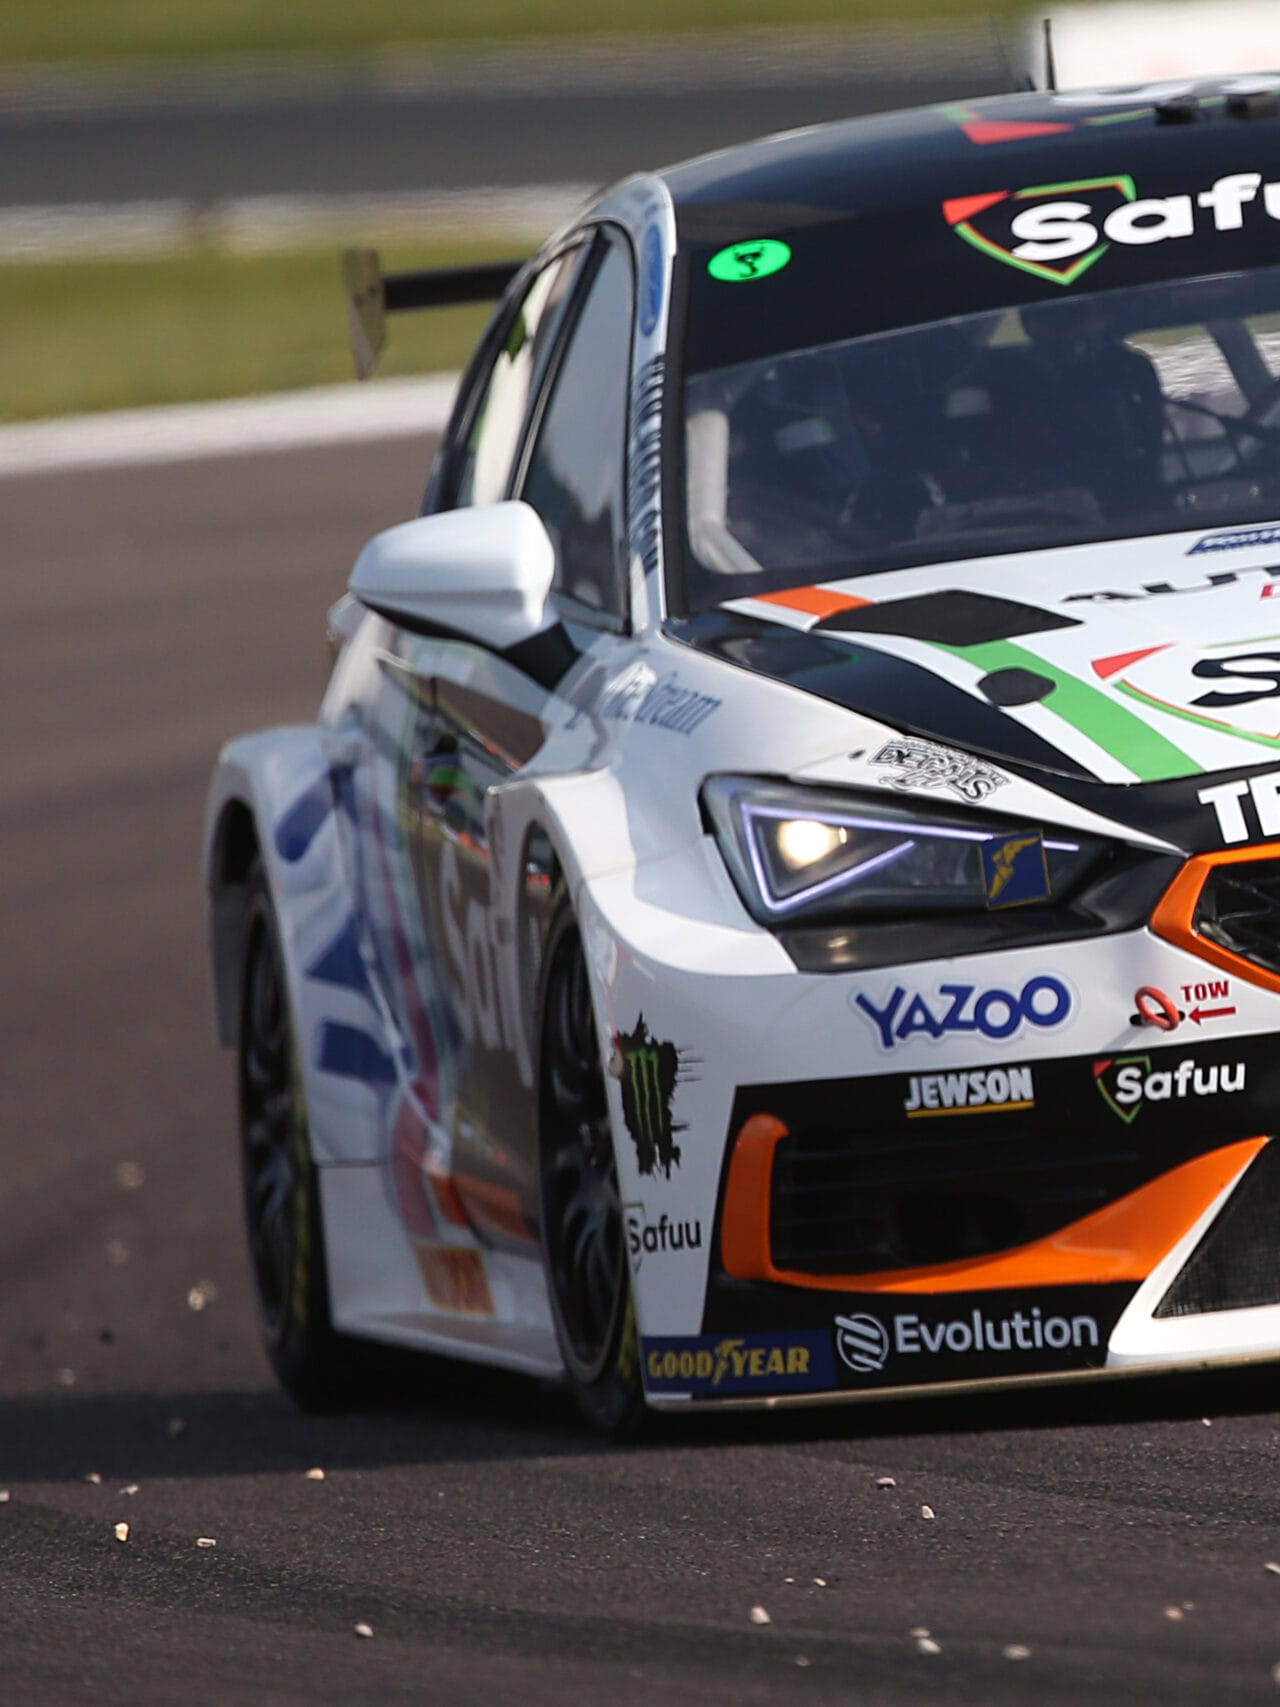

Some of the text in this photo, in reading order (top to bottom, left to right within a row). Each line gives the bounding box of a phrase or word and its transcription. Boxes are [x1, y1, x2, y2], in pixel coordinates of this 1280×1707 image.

[855, 975, 1071, 1049] YAZOO
[1180, 979, 1230, 1003] TOW
[903, 1066, 1034, 1112] JEWSON
[1115, 1059, 1246, 1105] Safuu
[627, 1213, 702, 1255] Safuu
[893, 1307, 1099, 1354] Evolution
[646, 1338, 811, 1387] GOODYEAR
